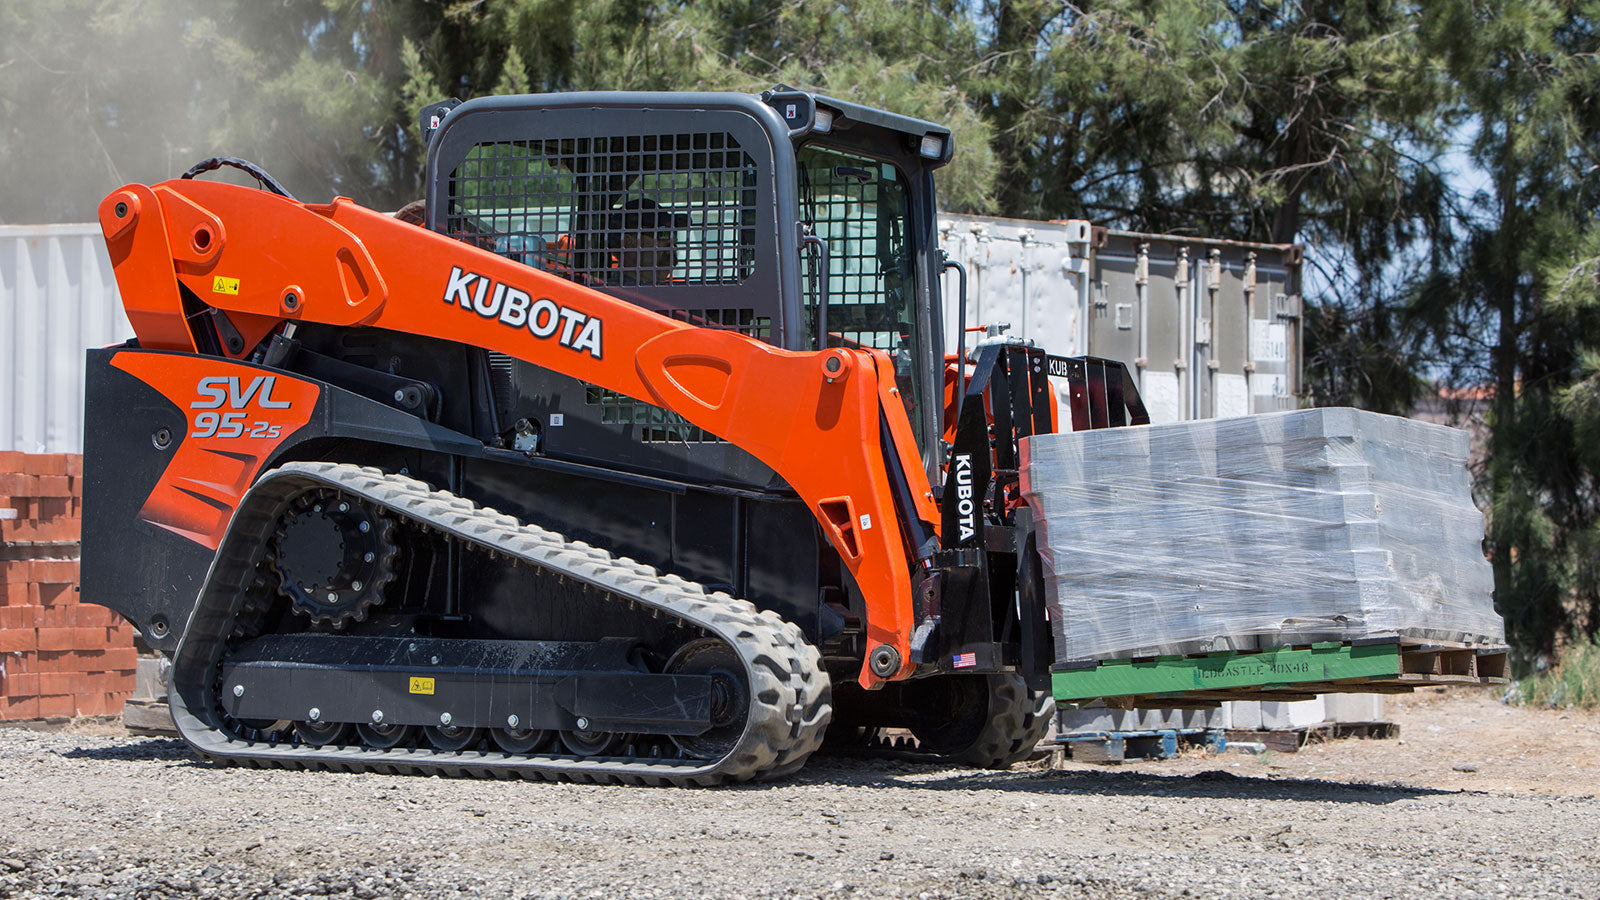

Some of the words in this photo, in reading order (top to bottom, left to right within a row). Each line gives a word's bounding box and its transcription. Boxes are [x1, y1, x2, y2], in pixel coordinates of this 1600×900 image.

[443, 265, 602, 360] KUBOTA
[190, 376, 292, 409] SVL
[1049, 359, 1068, 376] KUB
[955, 454, 976, 541] KUBOTA
